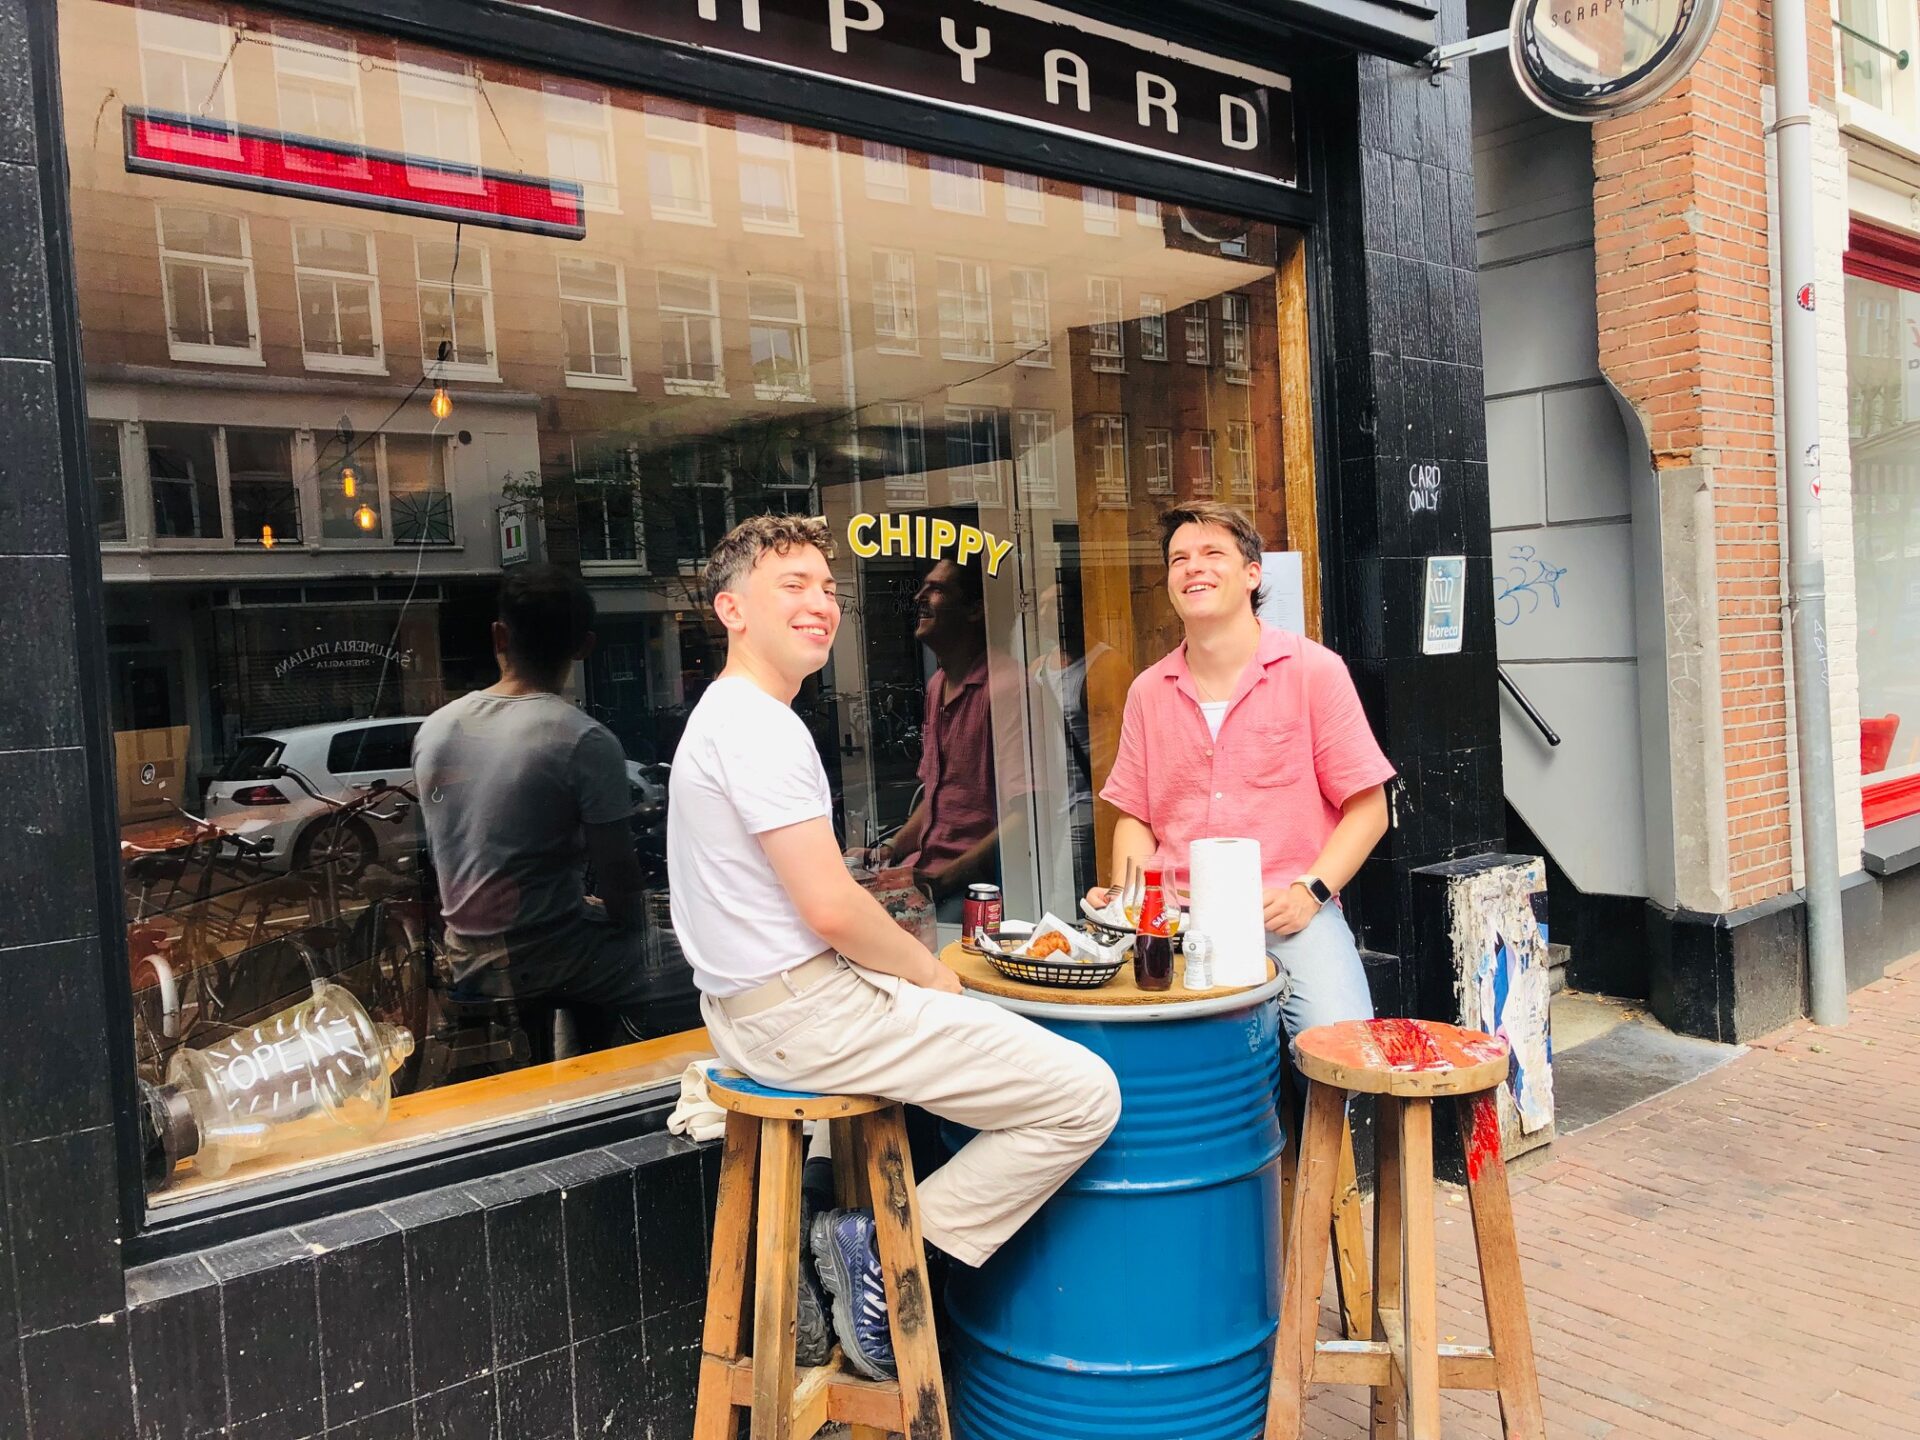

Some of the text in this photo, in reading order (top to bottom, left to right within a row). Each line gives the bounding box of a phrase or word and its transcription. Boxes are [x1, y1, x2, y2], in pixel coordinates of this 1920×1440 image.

[1409, 463, 1440, 488] CARD
[1409, 490, 1439, 512] ONLY
[847, 513, 1013, 578] CHIPPY
[1428, 625, 1458, 638] Horeca
[228, 1024, 335, 1090] OPEN
